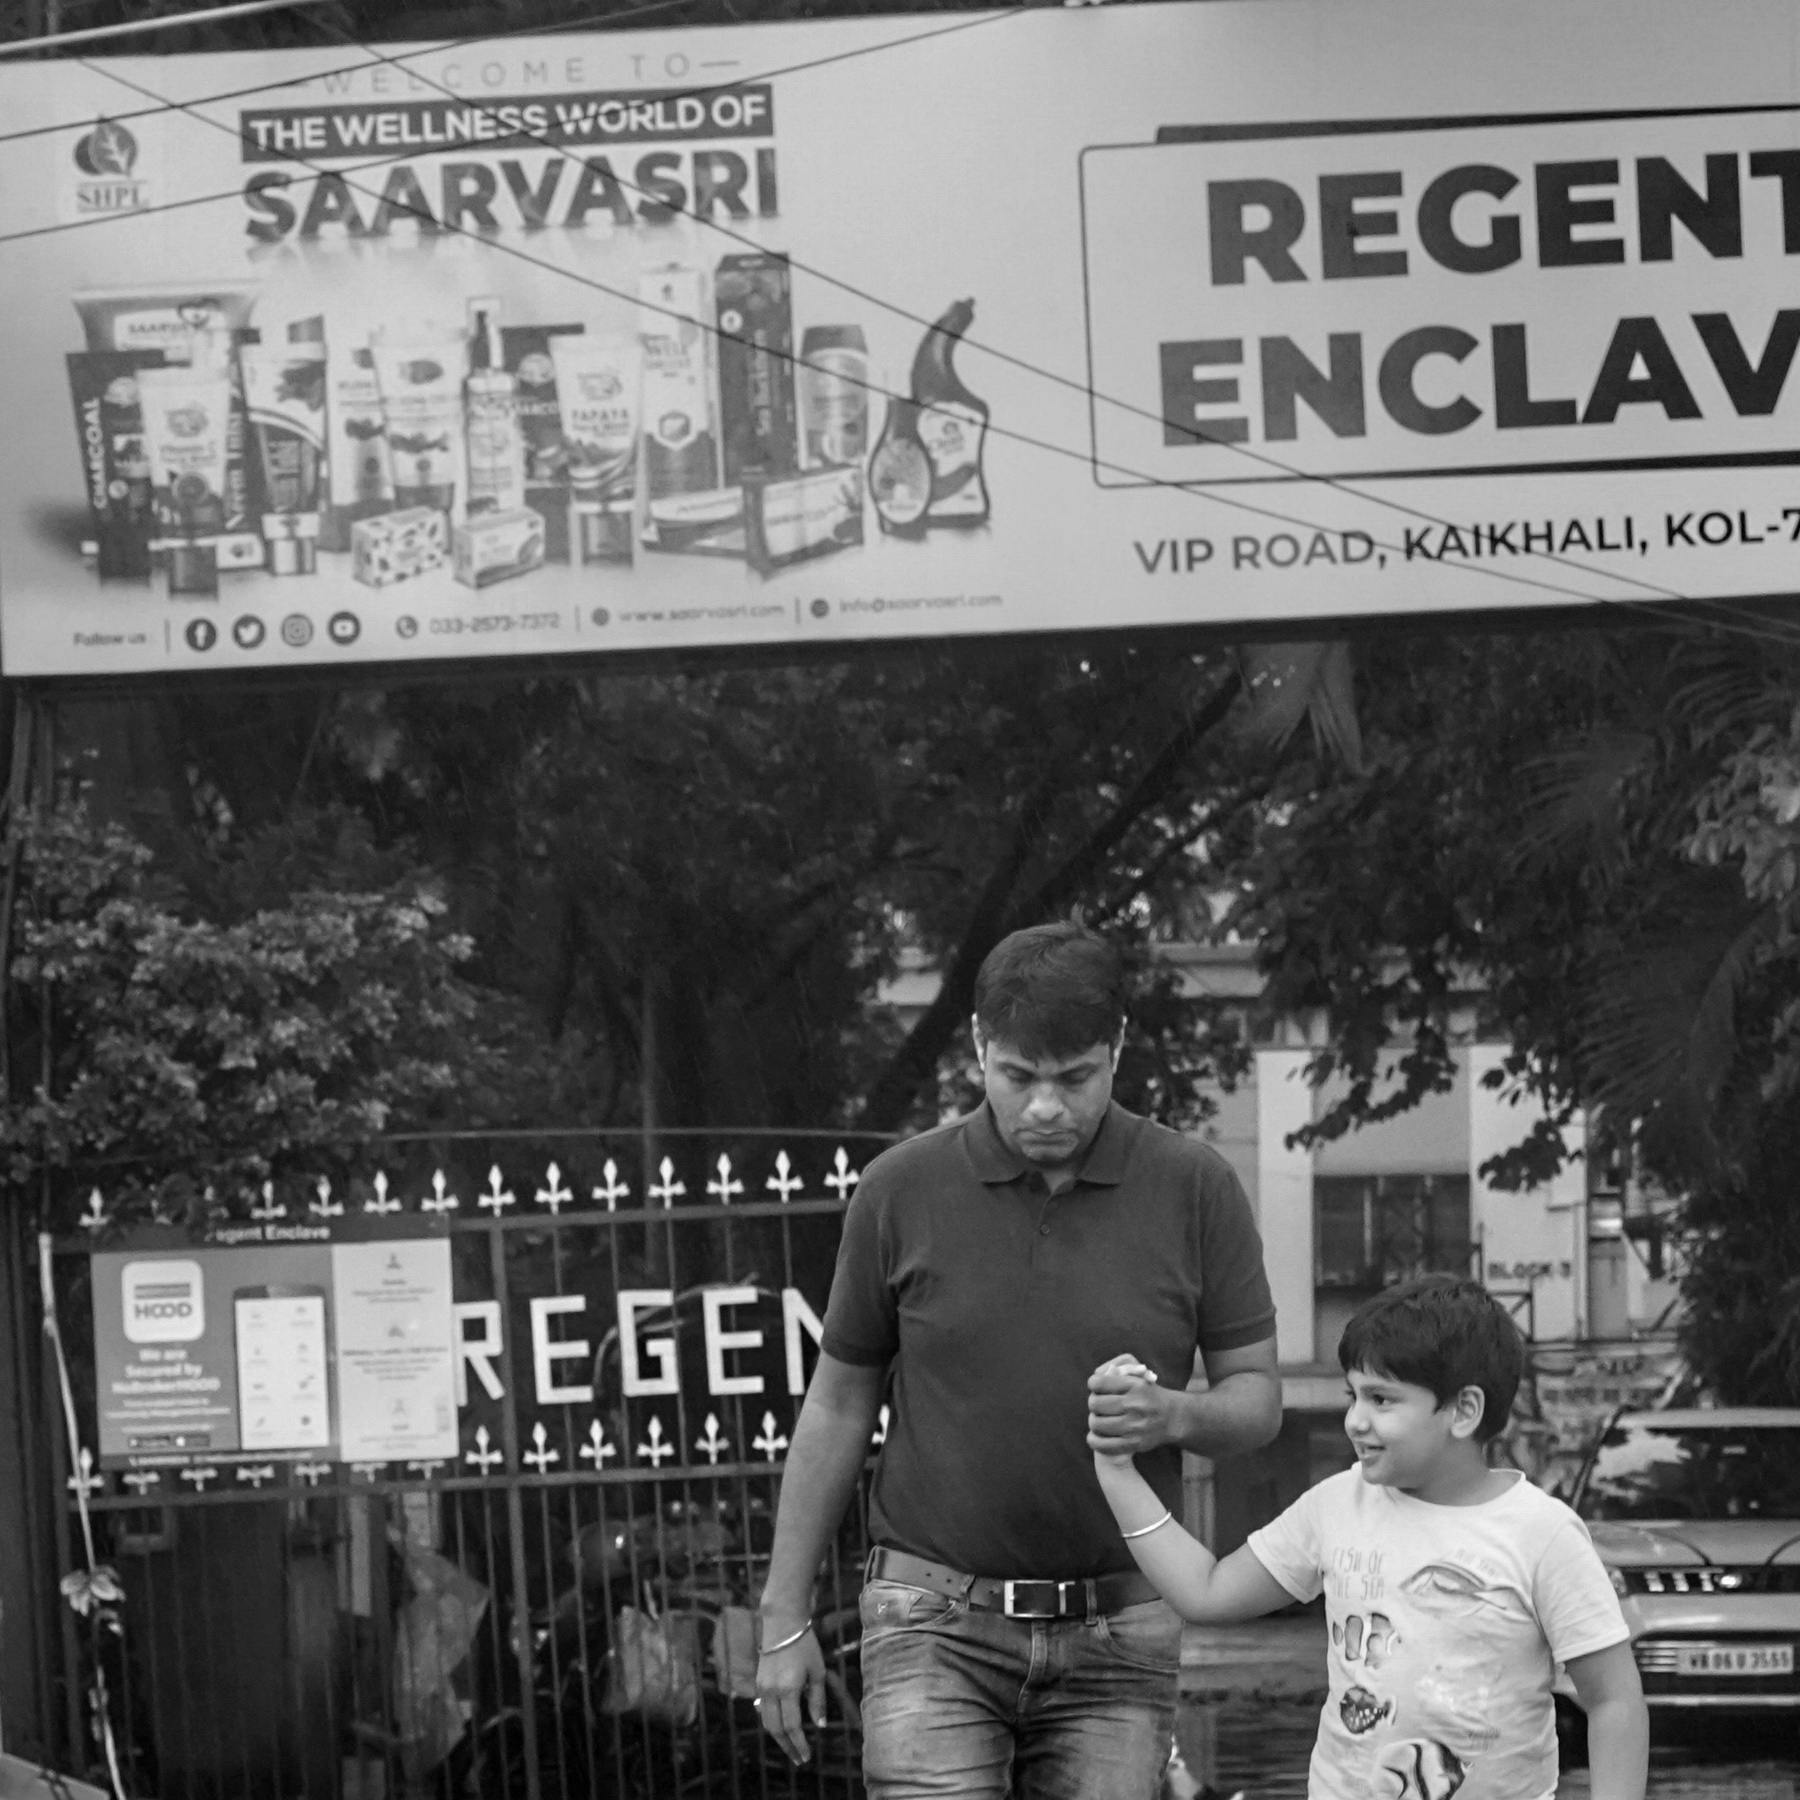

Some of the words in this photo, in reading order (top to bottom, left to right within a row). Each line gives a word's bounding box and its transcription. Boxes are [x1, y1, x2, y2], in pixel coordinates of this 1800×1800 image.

[324, 57, 585, 95] WELCOME
[631, 52, 691, 80] TO
[250, 116, 327, 152] THE
[333, 105, 548, 147] WELLNESS
[555, 98, 705, 136] WORLD
[711, 94, 766, 128] OF
[243, 148, 778, 241] SAARVASRI
[82, 398, 107, 509] CHARCOAL
[1133, 537, 1213, 576] VIP
[1232, 528, 1390, 571] ROAD,
[1403, 515, 1649, 565] KAIKHALI,
[73, 631, 123, 646] Follow
[128, 632, 147, 646] us
[135, 1302, 193, 1319] HOOD
